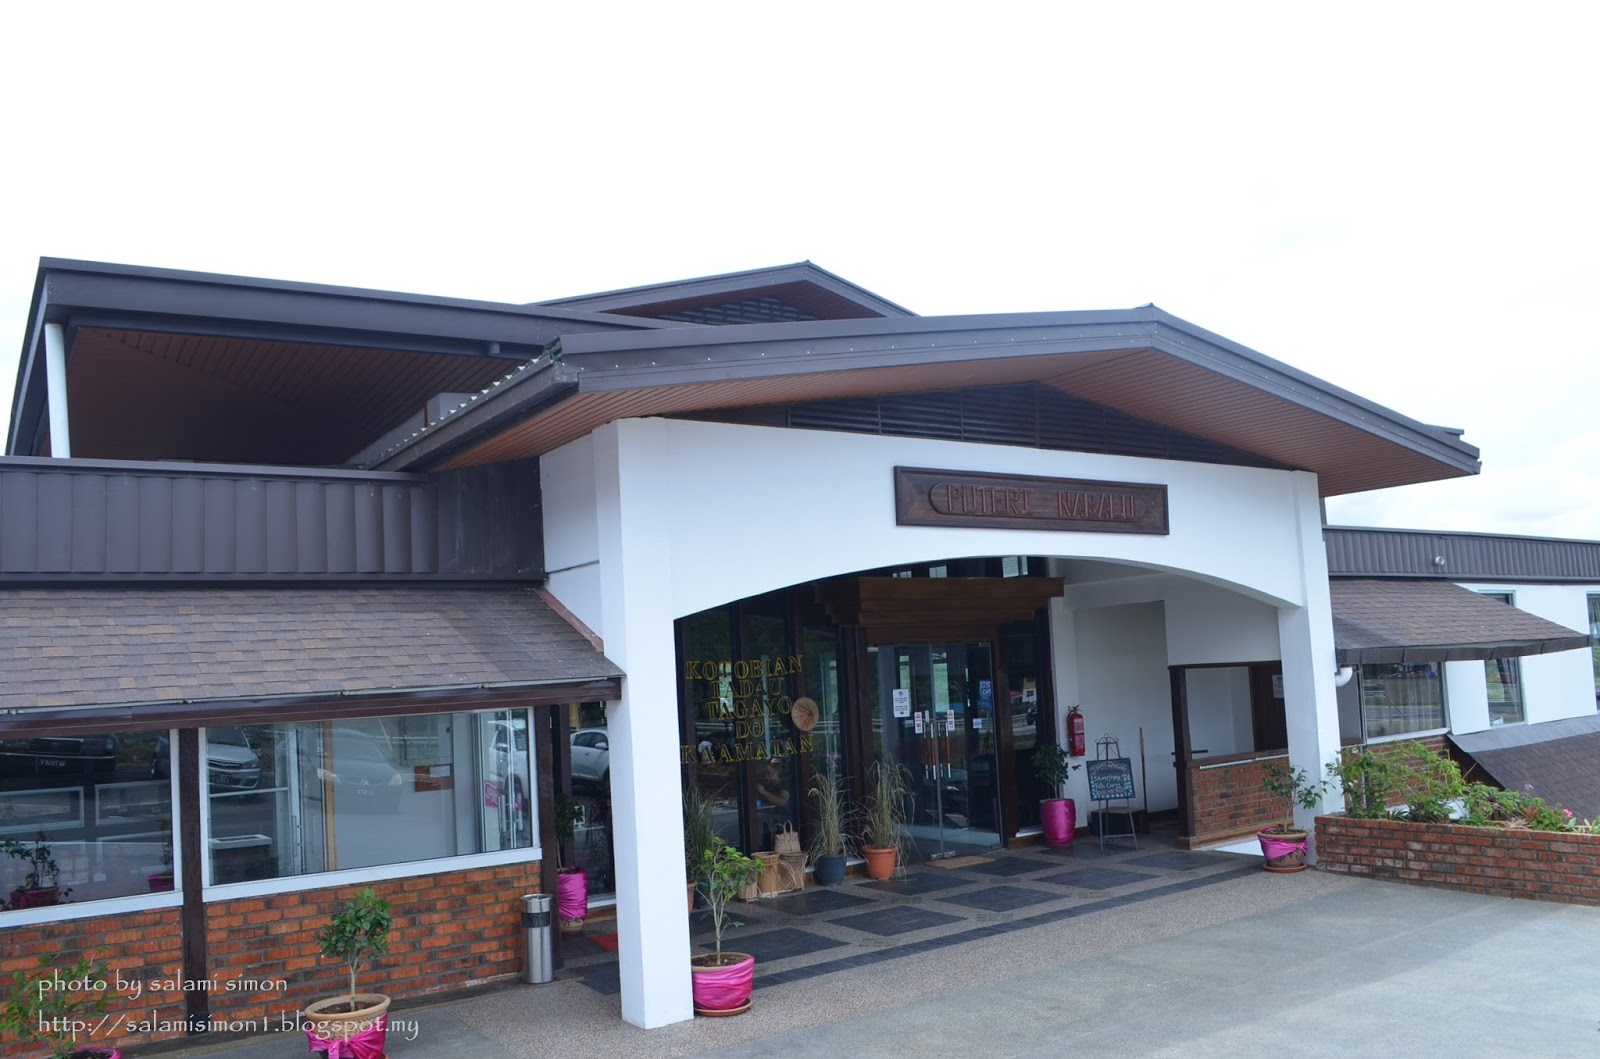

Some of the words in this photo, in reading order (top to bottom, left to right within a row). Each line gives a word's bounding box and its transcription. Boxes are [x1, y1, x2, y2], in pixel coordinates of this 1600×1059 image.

[946, 484, 1034, 516] PUTERI
[685, 655, 803, 681] KOTOBIAN
[710, 677, 784, 699] TADAU
[705, 695, 793, 720] TAGAYO
[735, 720, 764, 739] DO
